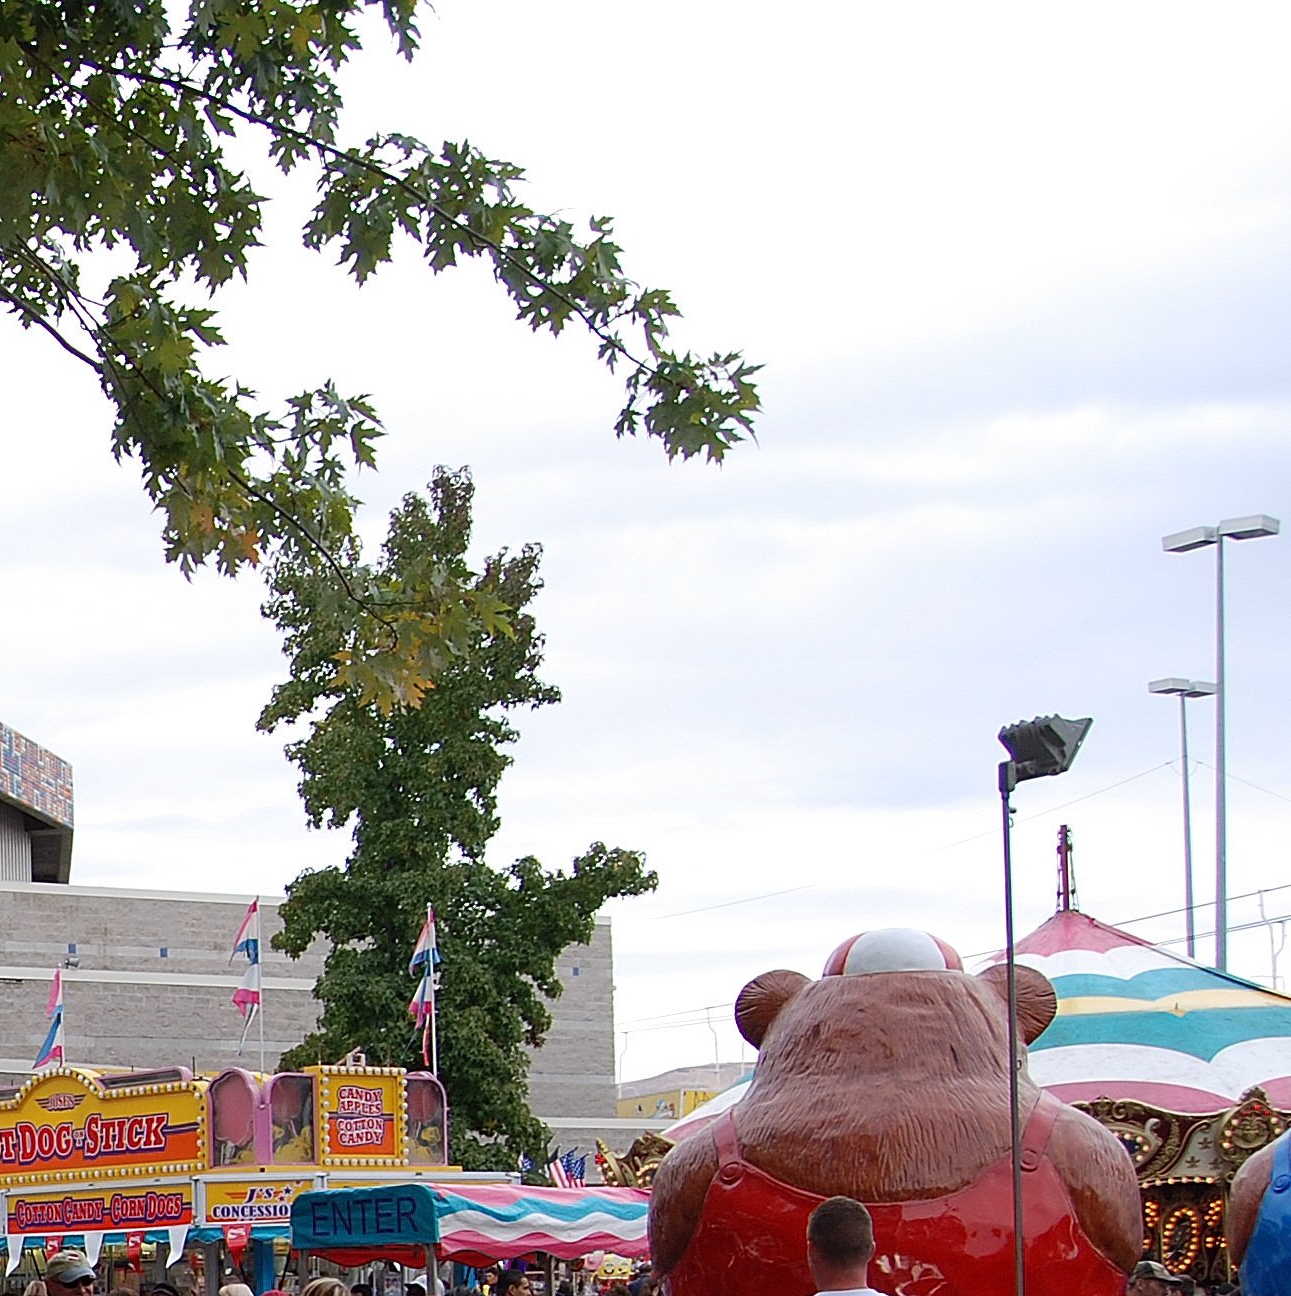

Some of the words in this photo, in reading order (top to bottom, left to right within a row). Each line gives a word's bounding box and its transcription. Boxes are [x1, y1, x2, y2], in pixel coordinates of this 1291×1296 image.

[339, 1087, 382, 1102] CANDY
[339, 1101, 382, 1116] APPLES
[337, 1118, 383, 1132] COTTON
[17, 1122, 73, 1163] DOG
[84, 1113, 169, 1157] STICK
[339, 1131, 382, 1145] CANDY
[16, 1200, 63, 1227] COTTON
[62, 1198, 104, 1224] CANDY
[111, 1194, 146, 1223] CORN
[146, 1193, 182, 1220] DOGS
[212, 1203, 290, 1219] CONCESSIO
[310, 1197, 419, 1237] ENTER
